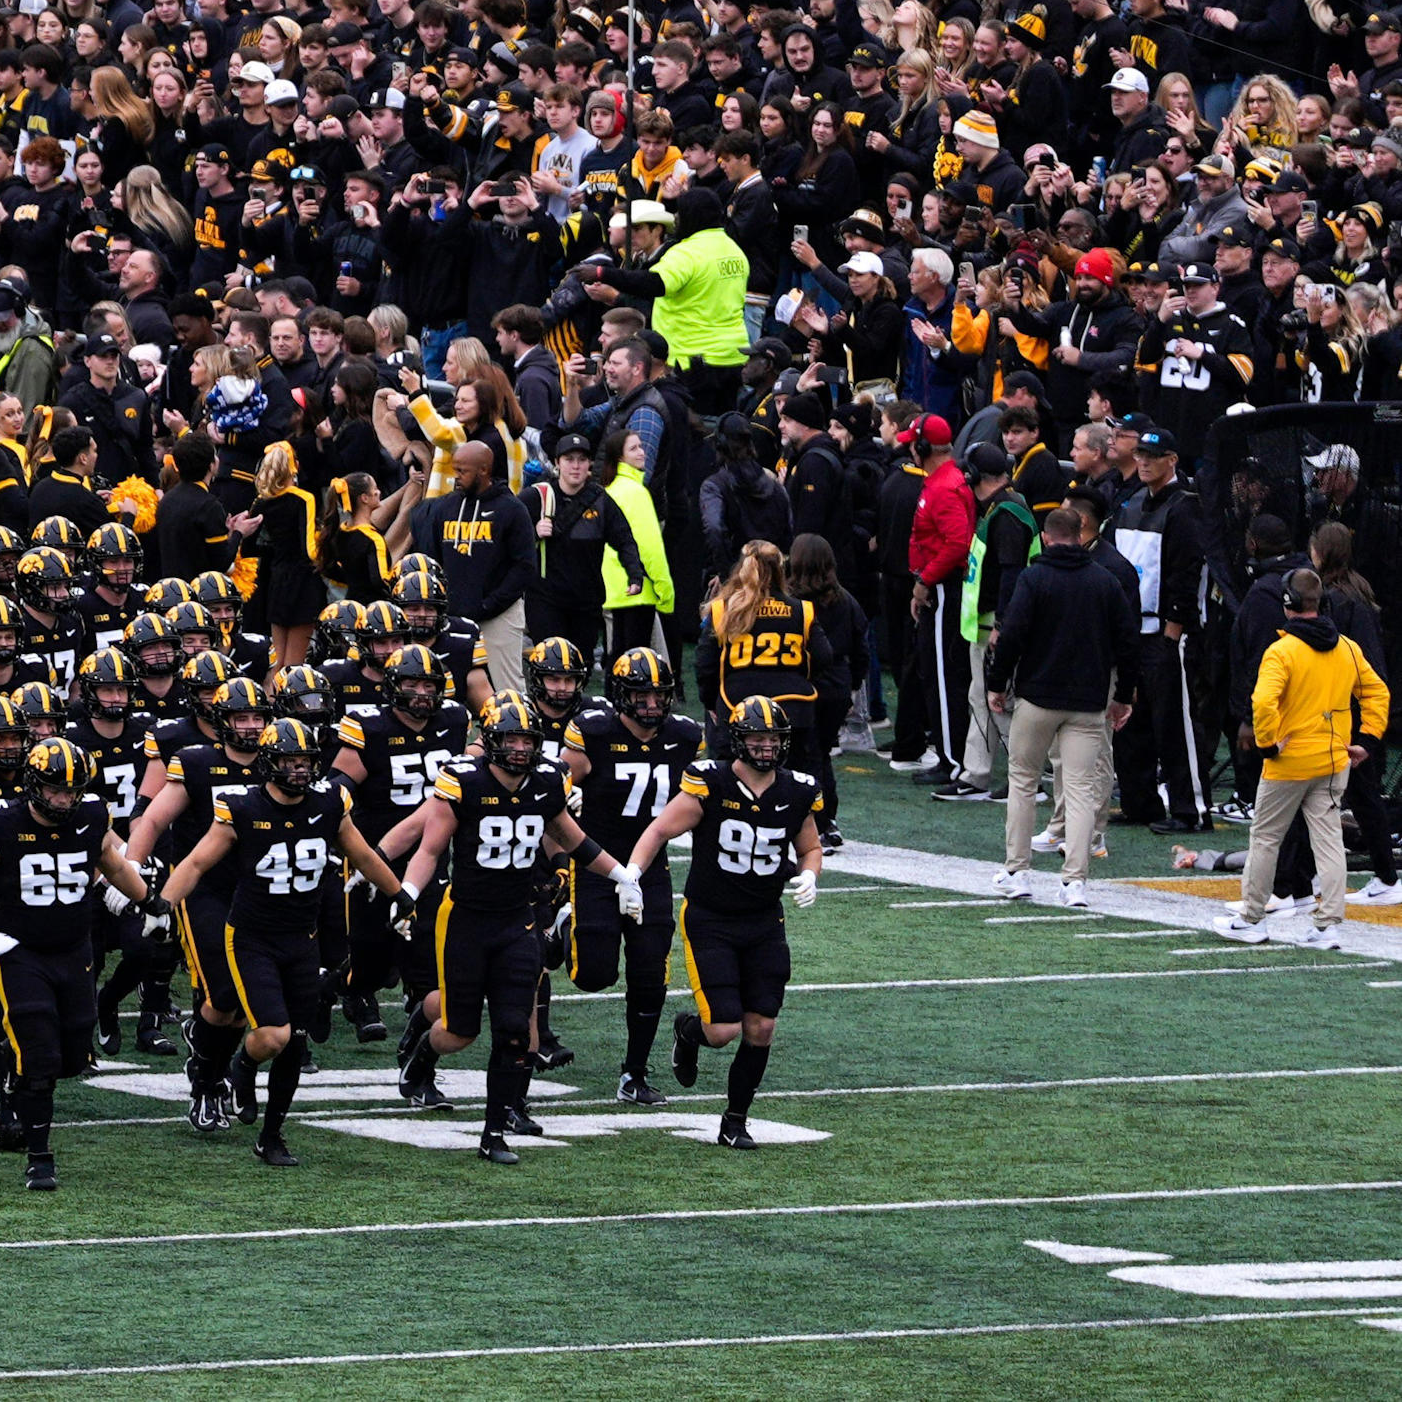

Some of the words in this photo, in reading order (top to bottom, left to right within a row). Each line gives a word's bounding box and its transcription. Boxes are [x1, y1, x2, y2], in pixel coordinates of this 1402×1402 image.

[1129, 34, 1158, 69] IOWA
[443, 519, 493, 540] IOWA
[728, 632, 804, 668] 023
[614, 762, 671, 817] 71
[254, 837, 327, 894] 49
[476, 814, 545, 870] 88
[717, 818, 786, 876] 95
[17, 850, 89, 906] 65
